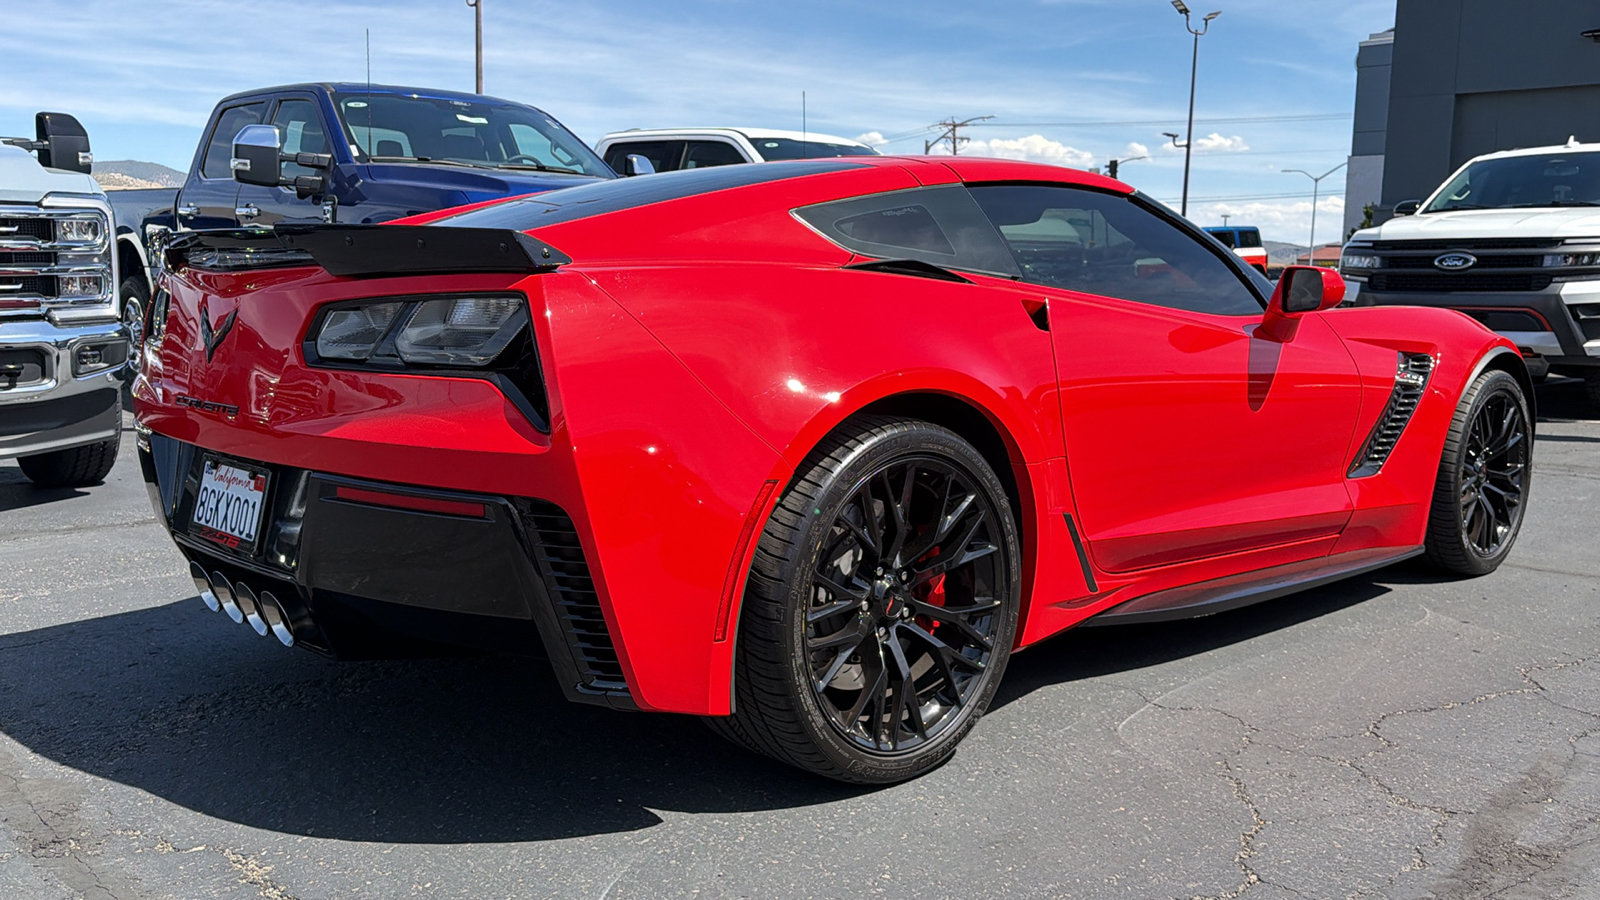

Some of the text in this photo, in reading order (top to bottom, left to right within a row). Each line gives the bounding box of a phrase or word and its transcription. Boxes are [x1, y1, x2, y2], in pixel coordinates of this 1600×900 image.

[1442, 257, 1464, 266] Ford
[176, 396, 240, 415] CORVETTE
[213, 463, 255, 491] California
[197, 487, 256, 540] 8GKX001
